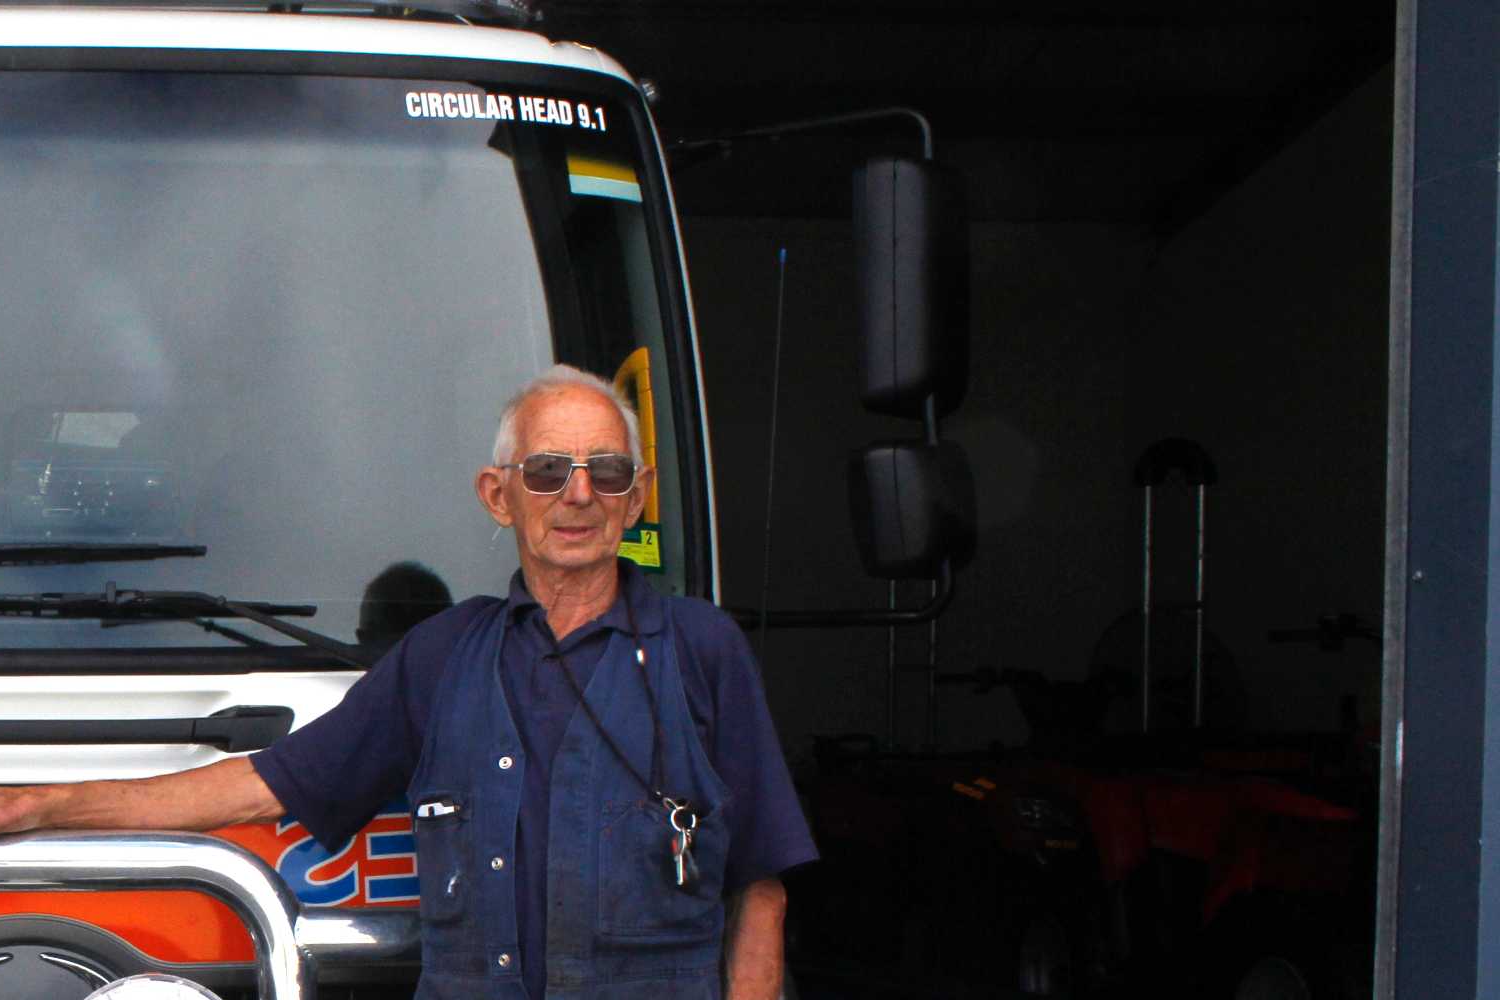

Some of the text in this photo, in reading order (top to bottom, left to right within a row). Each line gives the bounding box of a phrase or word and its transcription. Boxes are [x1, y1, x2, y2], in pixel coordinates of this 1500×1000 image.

[405, 92, 607, 131] CIRCULAR HEAD 9.1
